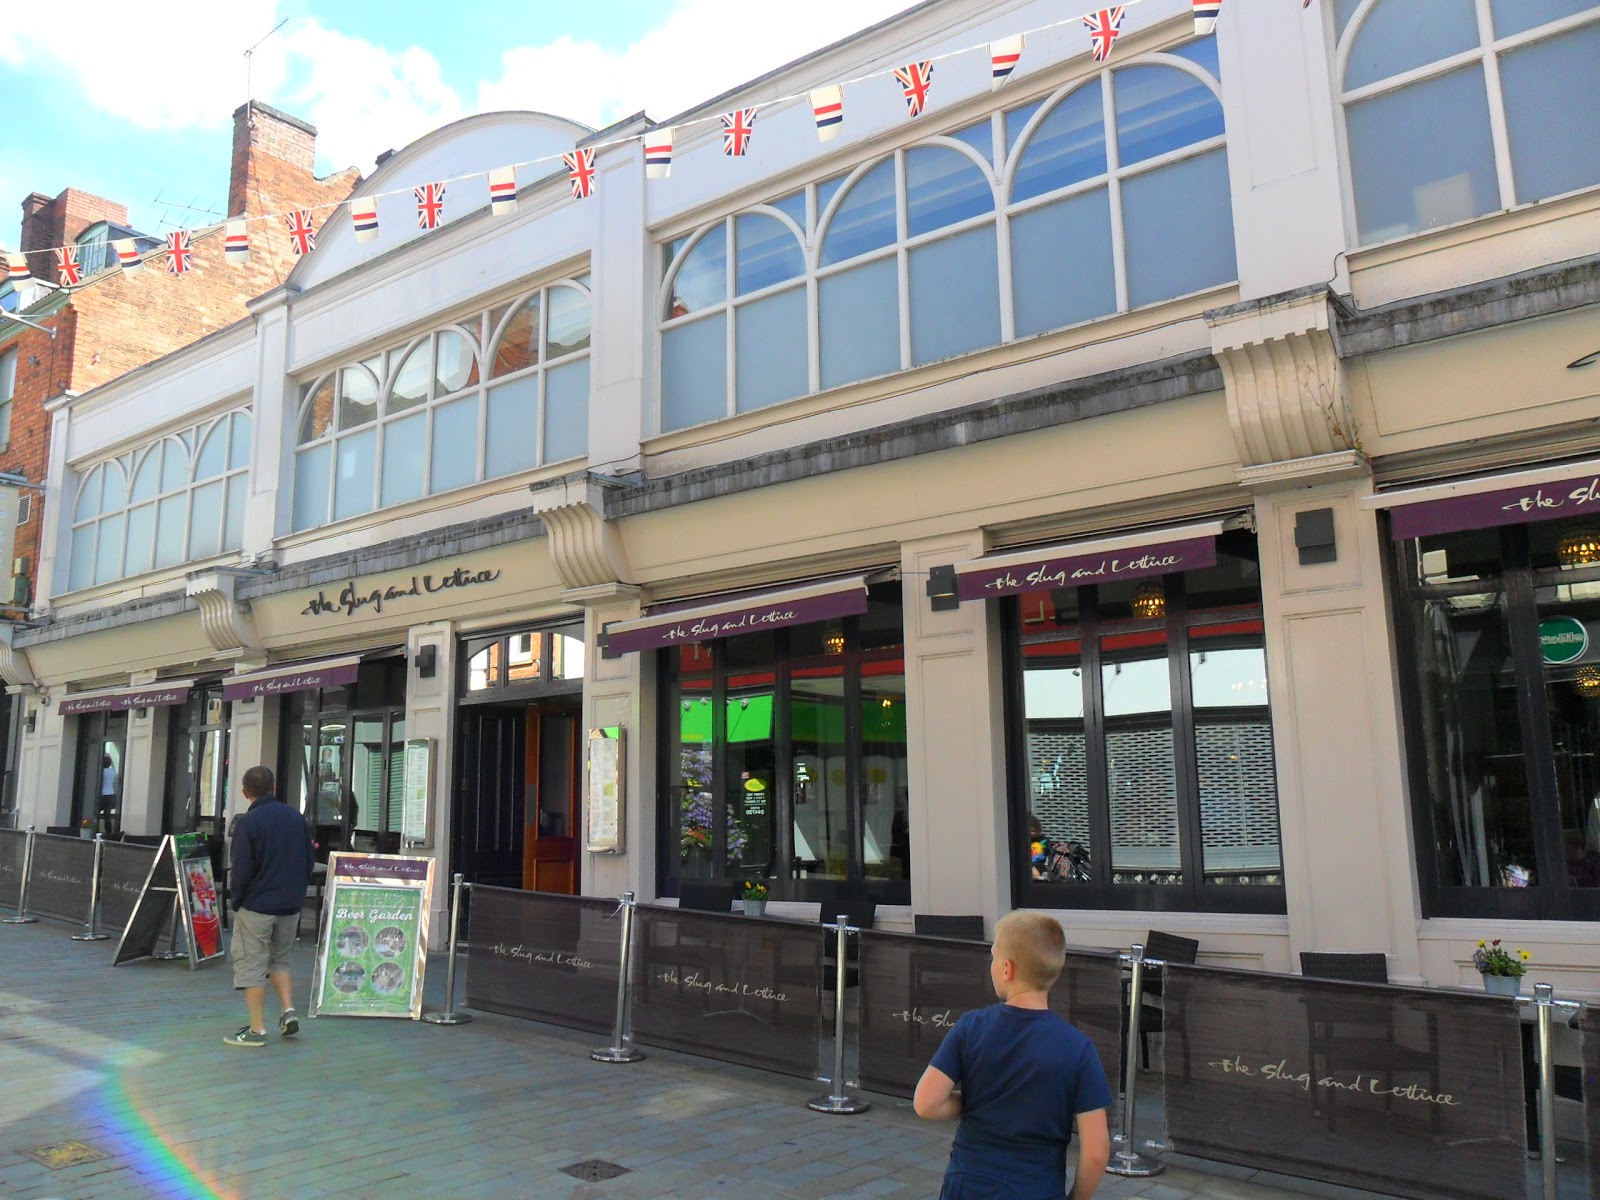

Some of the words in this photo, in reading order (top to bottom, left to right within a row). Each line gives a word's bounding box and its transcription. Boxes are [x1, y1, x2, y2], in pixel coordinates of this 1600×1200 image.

[1502, 489, 1565, 512] the
[985, 572, 1024, 591] the
[1071, 561, 1106, 578] and
[1111, 554, 1183, 573] Lettuce
[301, 591, 341, 615] the
[384, 577, 420, 601] and
[423, 567, 500, 593] Lettuce
[662, 624, 690, 640] the
[721, 615, 746, 629] and
[749, 610, 799, 626] Lettuce
[336, 907, 366, 919] Beer
[369, 909, 414, 924] Garden
[535, 950, 554, 963] and
[657, 970, 682, 985] the
[714, 982, 740, 995] and
[742, 984, 791, 1002] Lettuce
[892, 1007, 928, 1026] the
[1208, 1056, 1257, 1076] the
[1317, 1075, 1361, 1091] and
[1369, 1078, 1464, 1106] Lettuce
